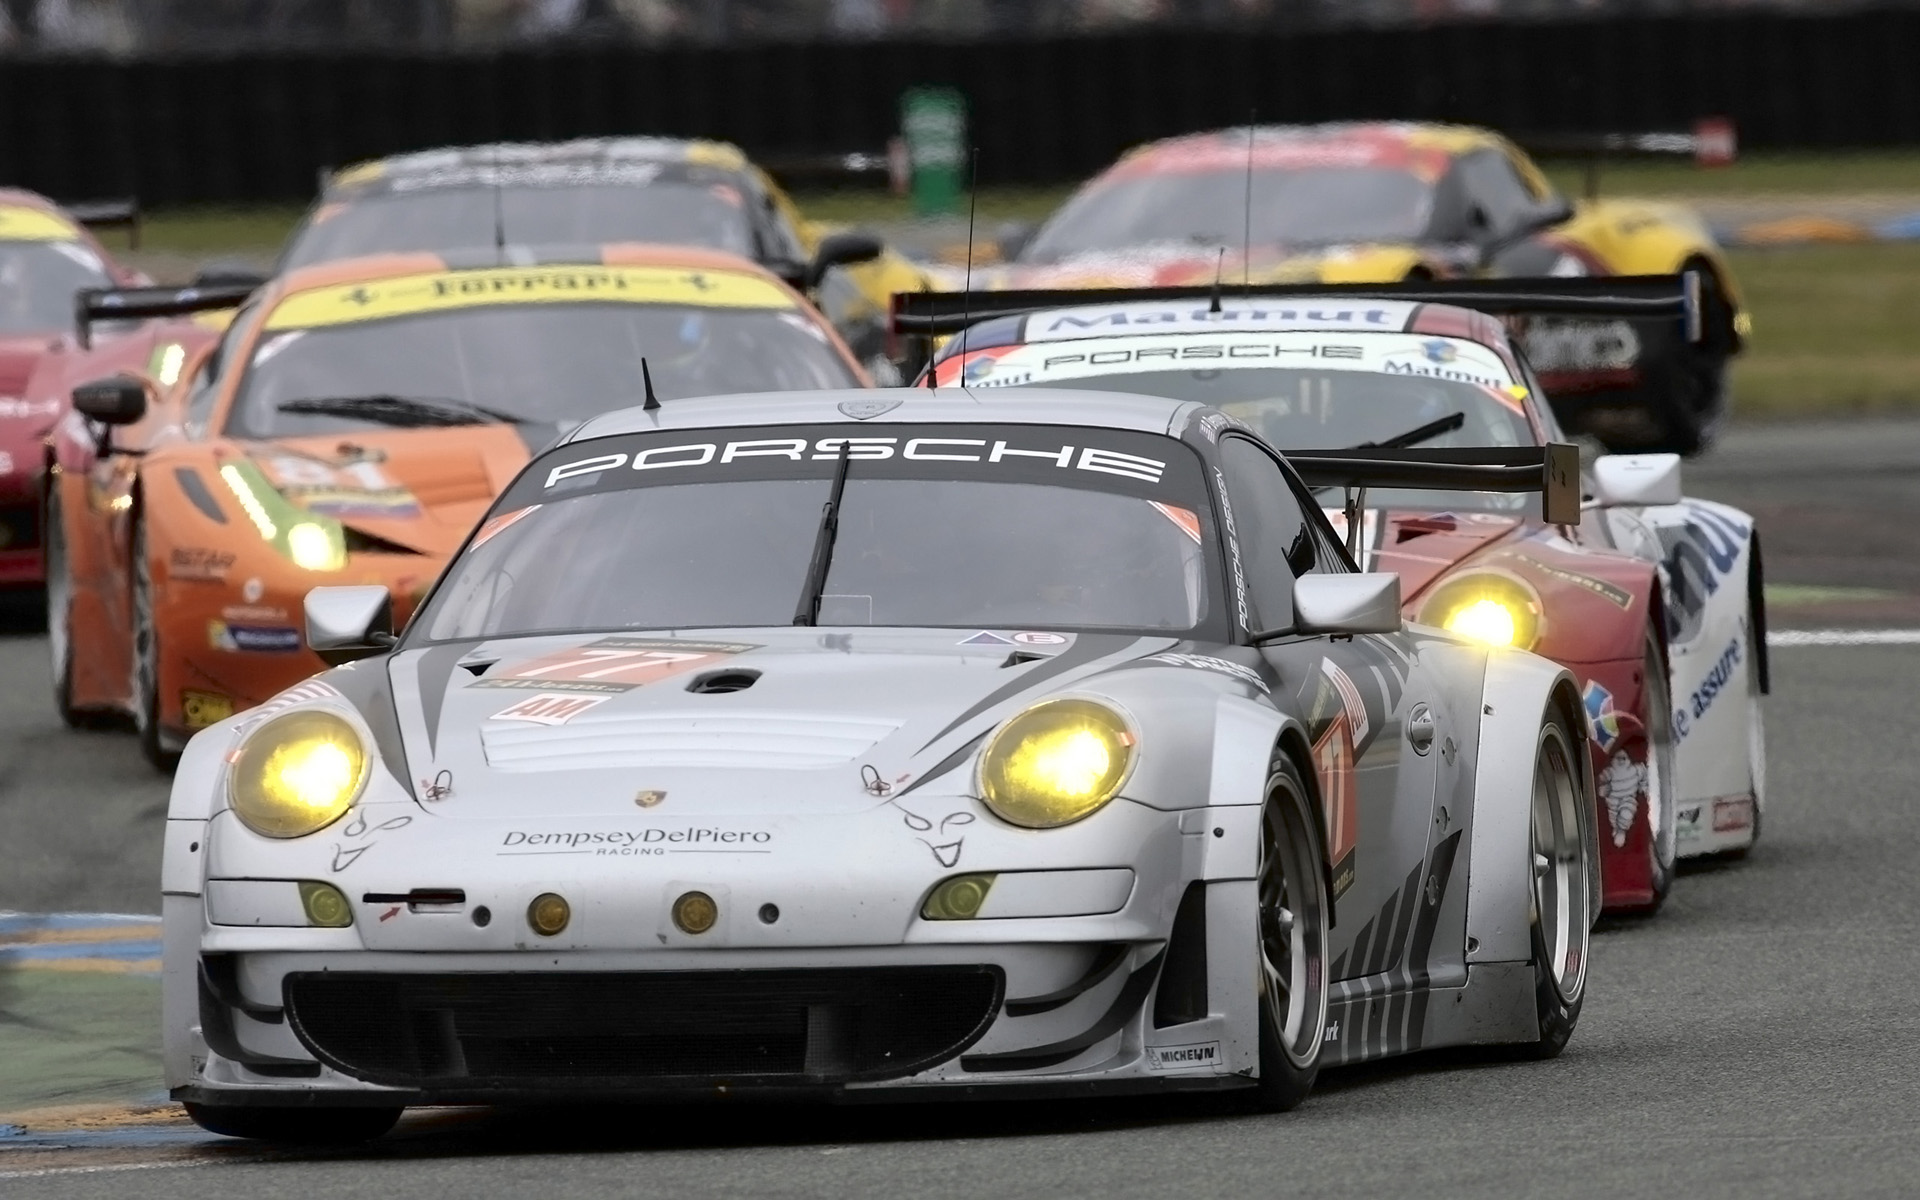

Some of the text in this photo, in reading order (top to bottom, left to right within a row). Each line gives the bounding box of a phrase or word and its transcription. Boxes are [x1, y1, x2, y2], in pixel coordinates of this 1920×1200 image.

[1047, 309, 1391, 332] Matmut
[1043, 345, 1364, 370] PORSCHE
[1384, 359, 1502, 389] Matmut
[543, 436, 1167, 489] PORSCHE
[1213, 465, 1250, 633] PORSCHE DESIGN
[515, 650, 708, 678] 77
[500, 697, 591, 718] AM
[502, 827, 771, 847] DempseyDelPiero
[596, 848, 665, 856] RACING
[1160, 1046, 1215, 1062] MICHELIN
